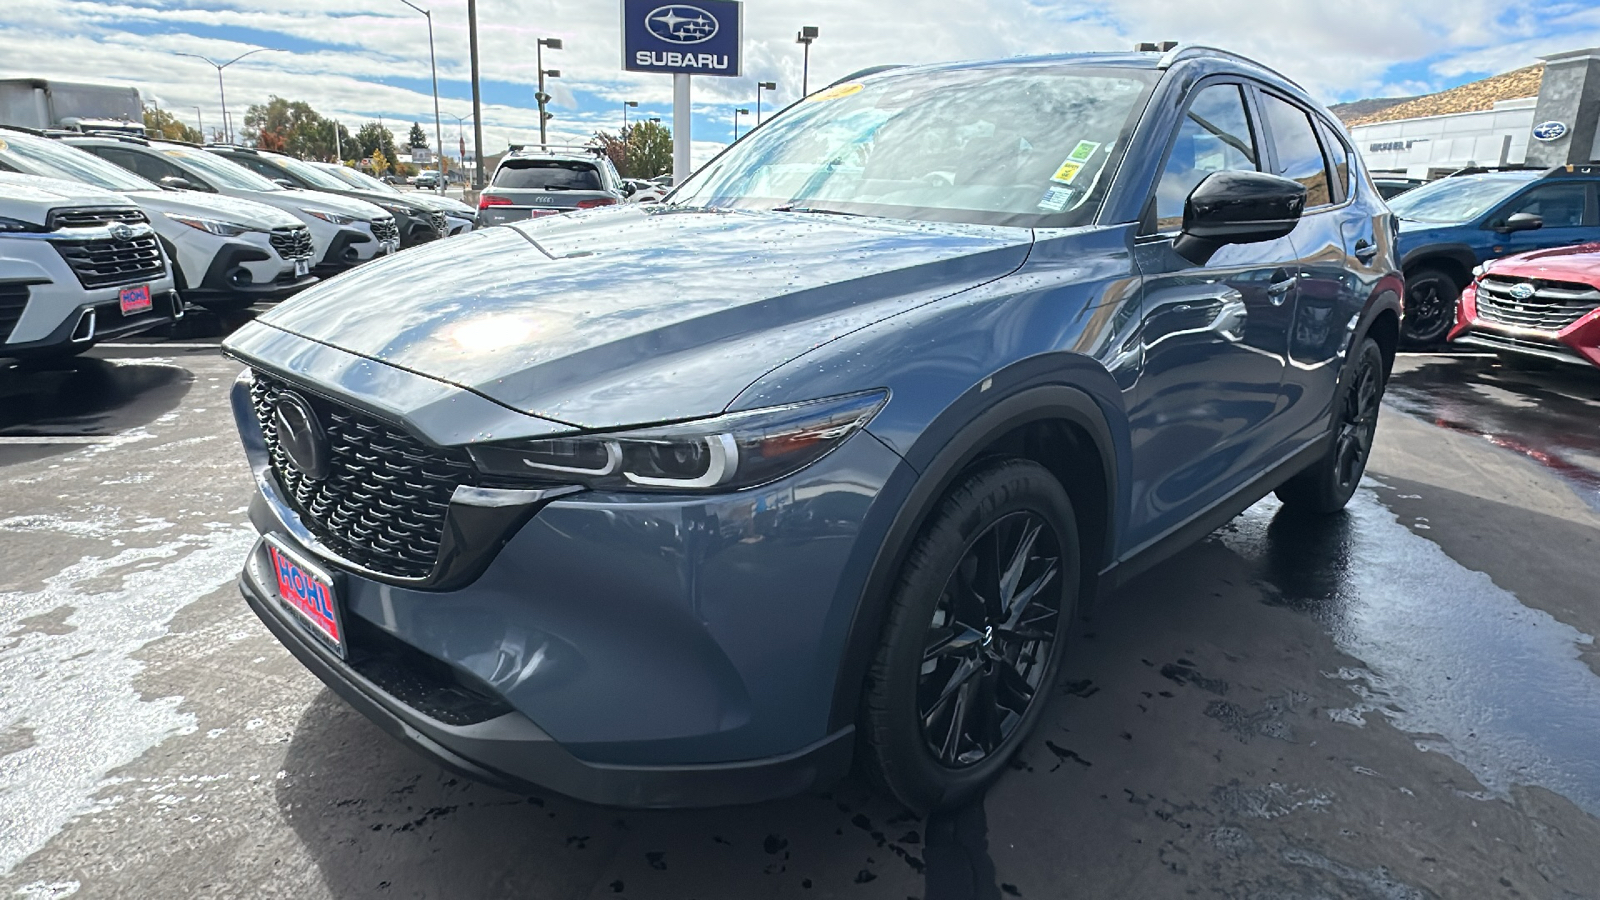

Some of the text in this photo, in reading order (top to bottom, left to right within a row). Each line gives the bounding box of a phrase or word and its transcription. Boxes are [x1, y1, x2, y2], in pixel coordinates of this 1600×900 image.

[636, 51, 728, 69] SUBARU
[122, 289, 147, 302] HOHL
[277, 555, 334, 621] HOHL
